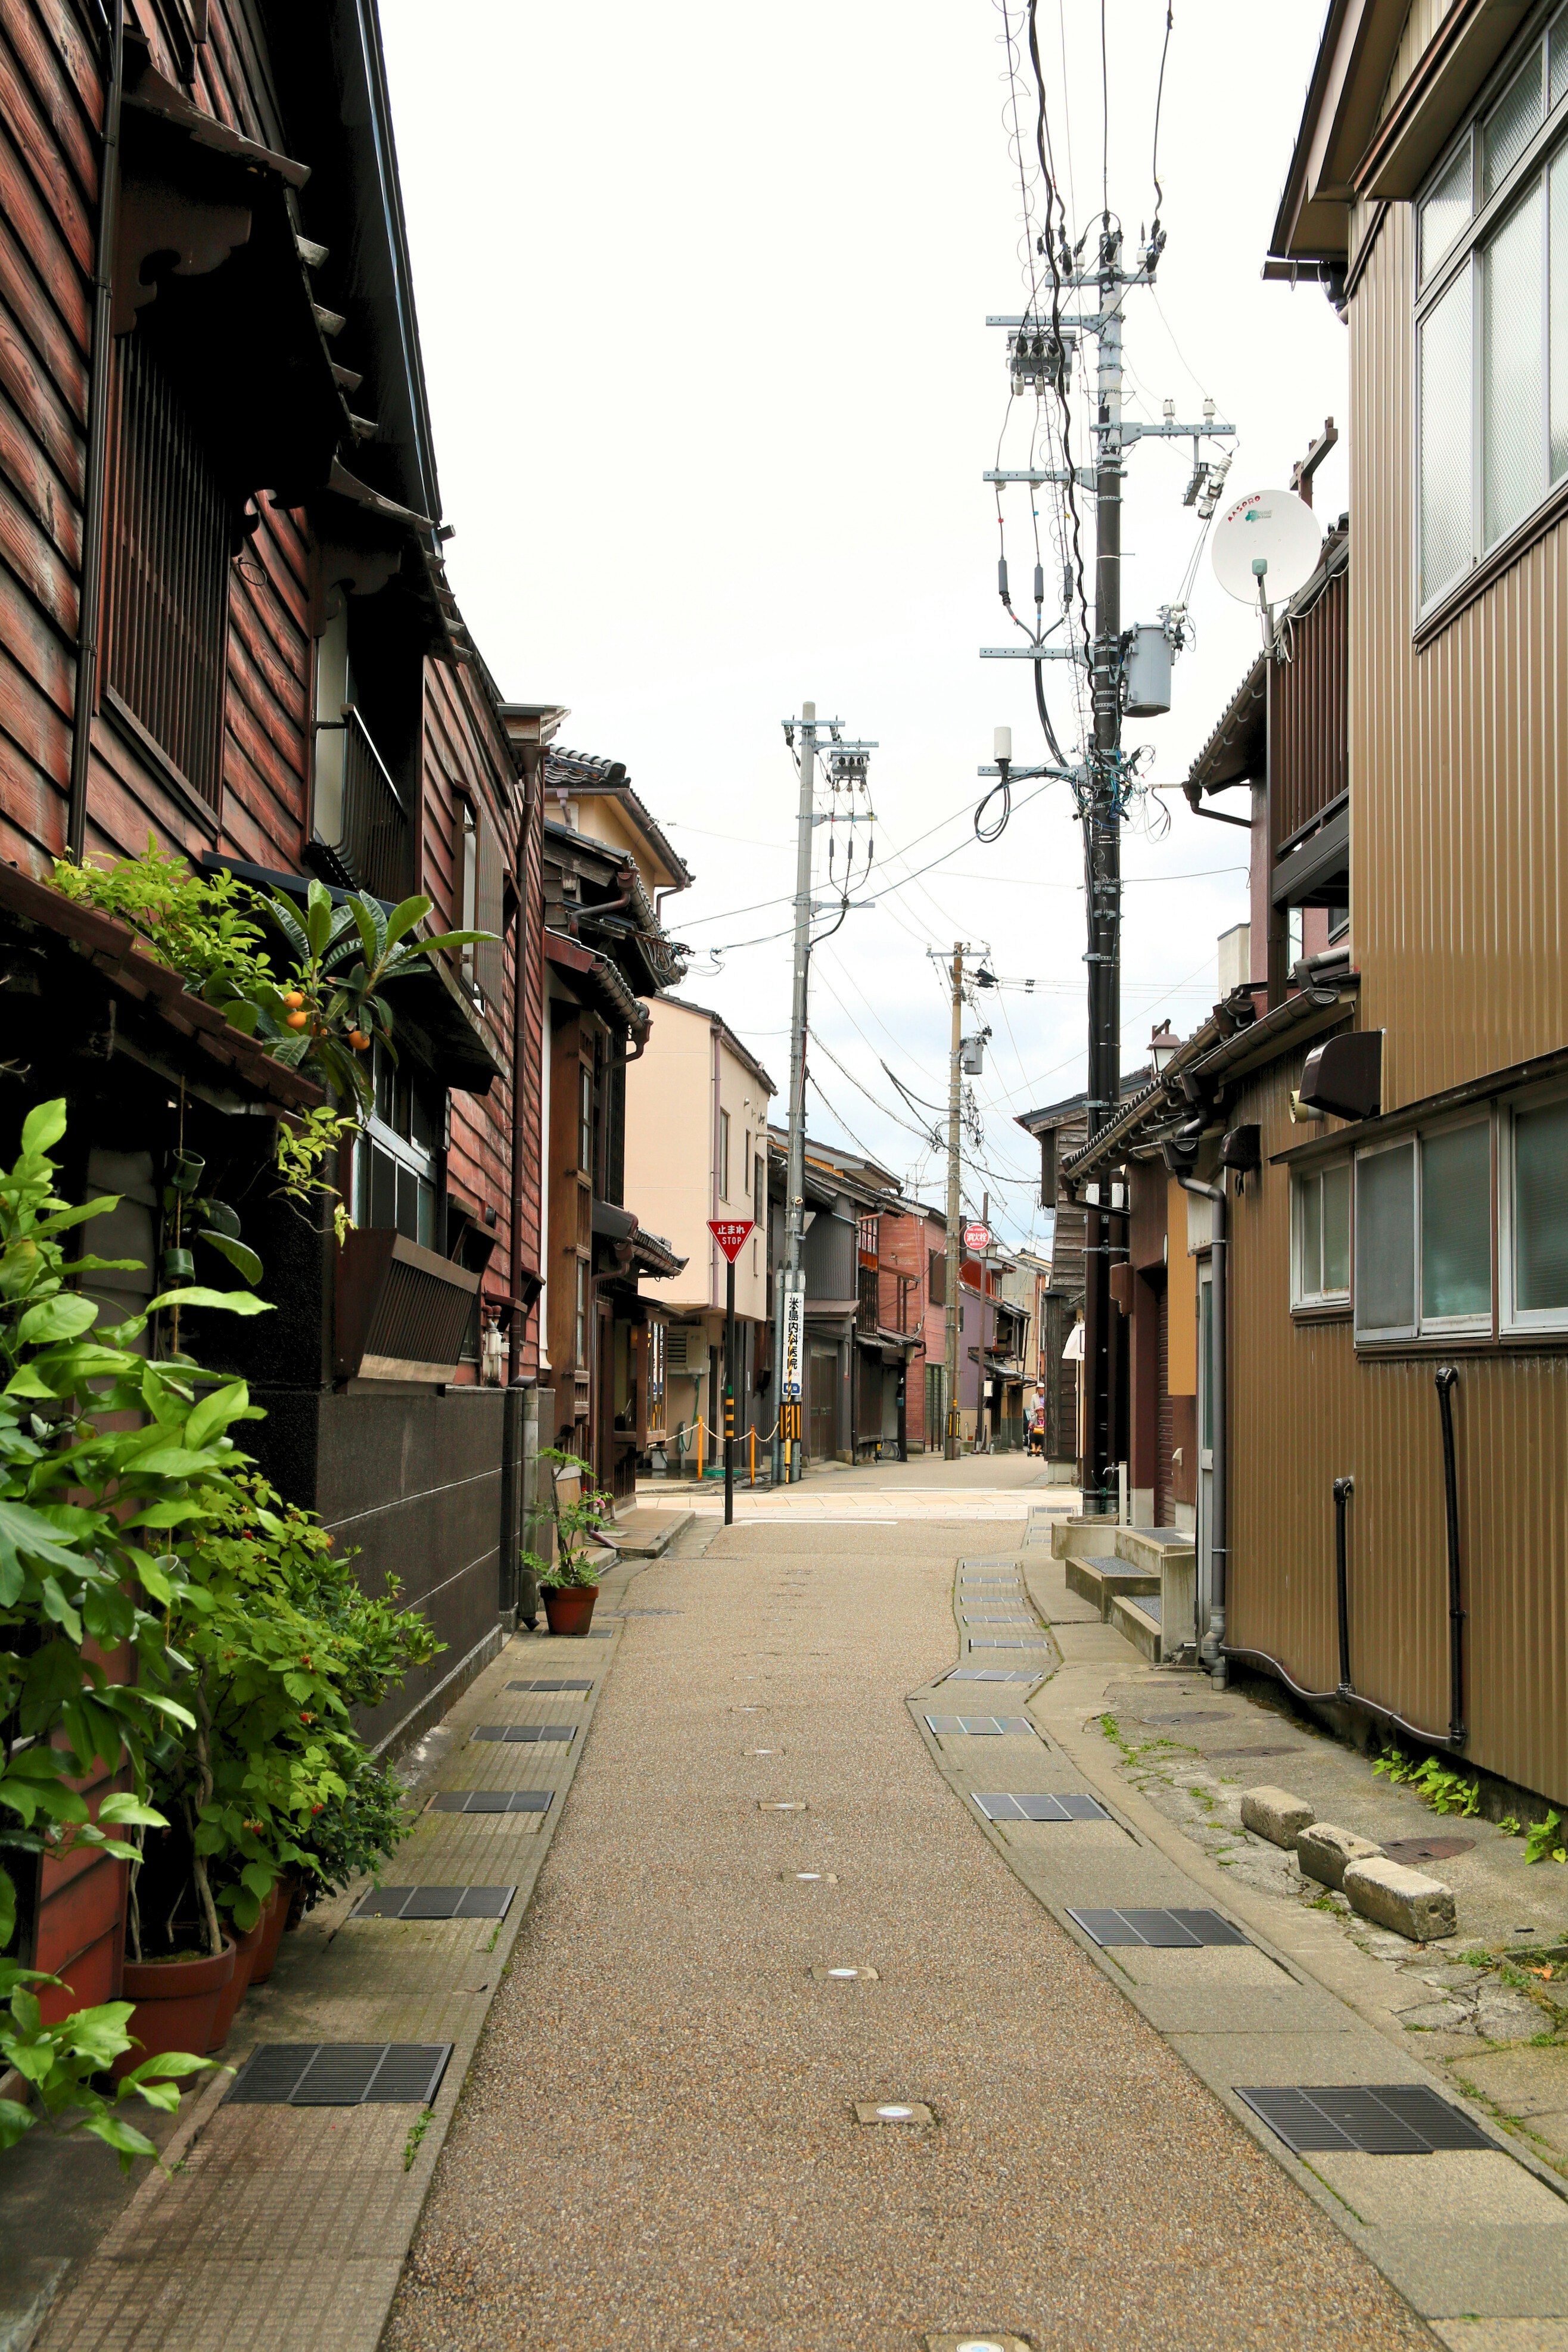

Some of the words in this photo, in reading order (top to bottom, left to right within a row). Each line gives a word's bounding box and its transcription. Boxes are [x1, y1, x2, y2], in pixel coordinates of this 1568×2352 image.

[717, 1225, 745, 1234] 止まれ
[966, 1233, 987, 1242] 消火栓
[787, 1298, 799, 1370] 米島内科医院
